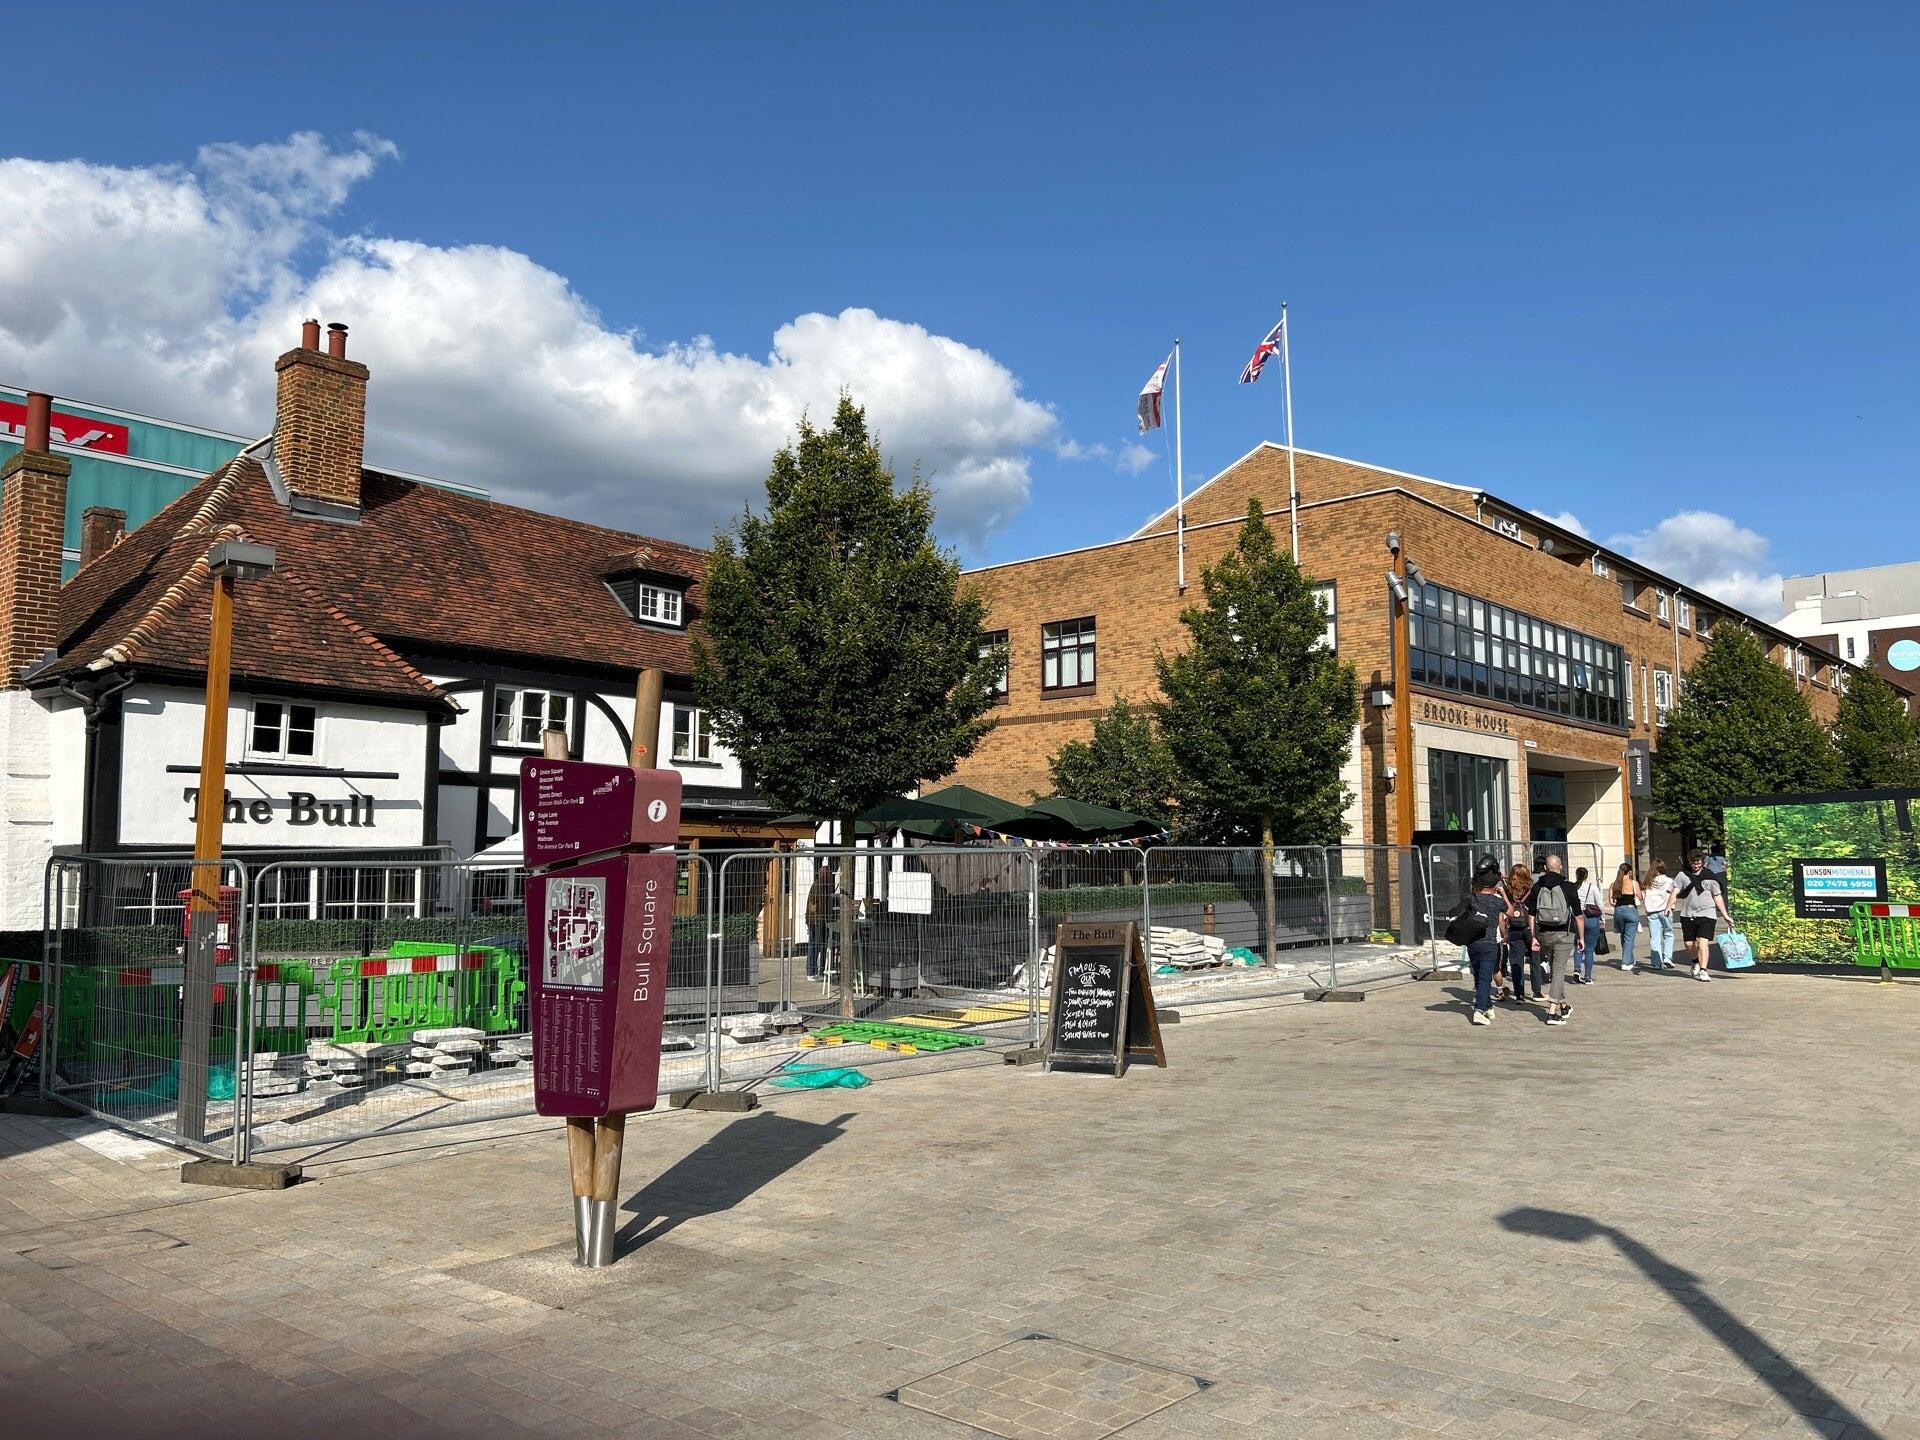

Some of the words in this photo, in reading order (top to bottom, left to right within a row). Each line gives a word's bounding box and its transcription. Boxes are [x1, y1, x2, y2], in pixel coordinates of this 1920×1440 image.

[1424, 702, 1468, 725] BROOKE
[1475, 713, 1508, 733] HOUSE
[286, 791, 376, 827] Bull
[638, 879, 658, 954] Square
[1072, 929, 1091, 940] The
[1094, 928, 1115, 939] Bull
[633, 961, 651, 1002] Bull
[1068, 962, 1096, 977] FAMOUS
[1099, 964, 1112, 978] FOR
[1080, 974, 1096, 985] OUR
